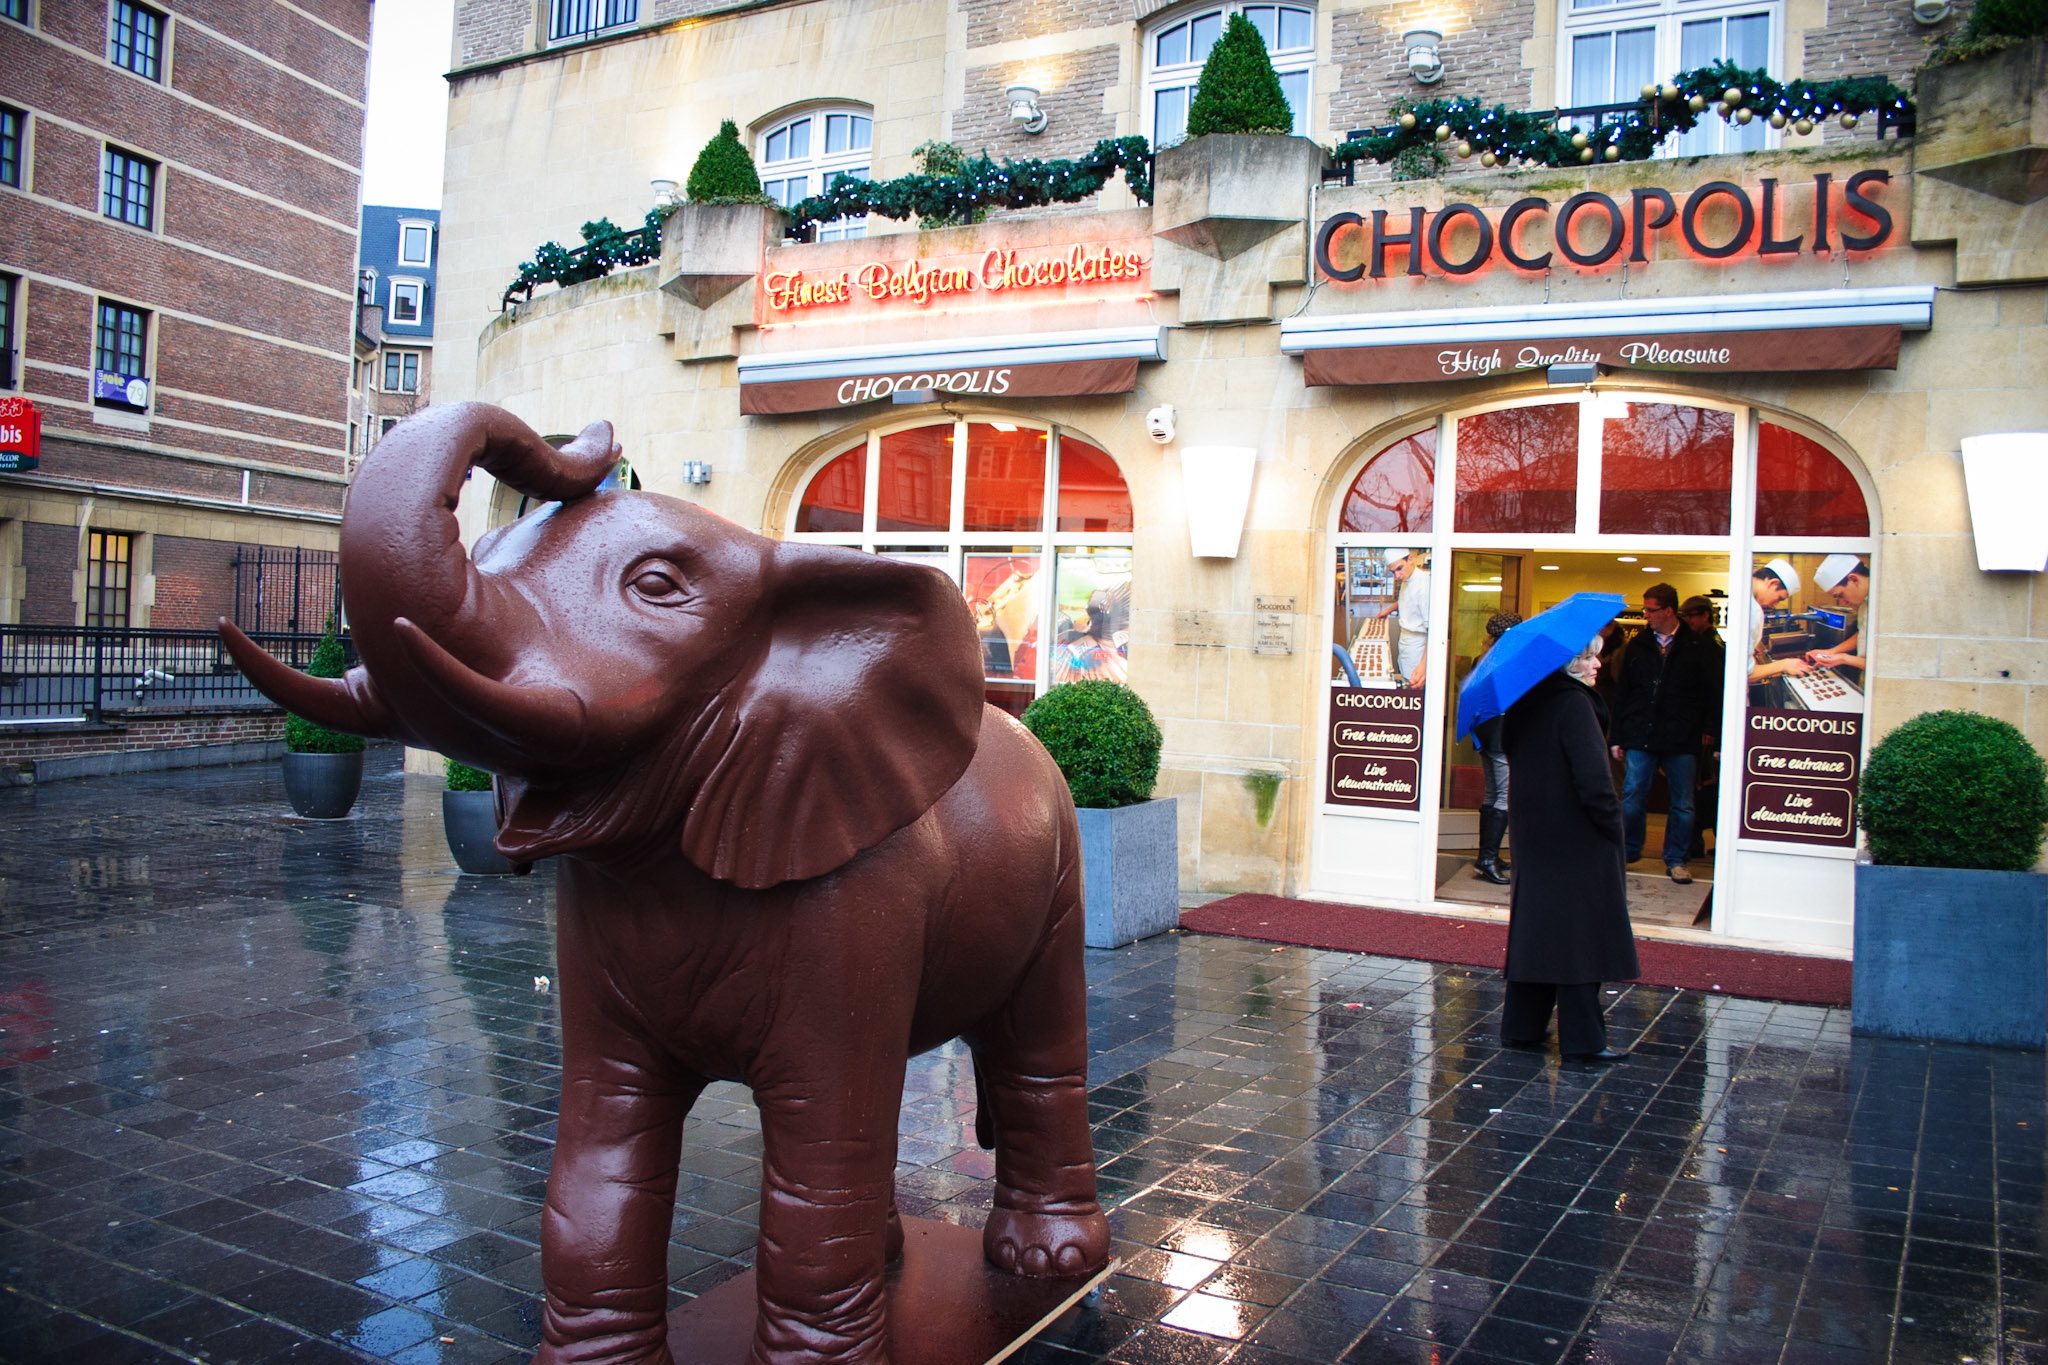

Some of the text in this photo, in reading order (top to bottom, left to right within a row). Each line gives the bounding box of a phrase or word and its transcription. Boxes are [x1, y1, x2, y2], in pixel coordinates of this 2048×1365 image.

[1315, 169, 1893, 282] CHOCOPOLIS
[764, 243, 1141, 310] Finest Belgian Chocolates
[1437, 349, 1501, 377] High
[1619, 342, 1730, 364] Pleasure
[129, 386, 144, 401] 79
[0, 424, 22, 443] bis
[1335, 693, 1422, 711] CHOCOPOLIS
[1751, 715, 1857, 735] CHOCOPOLIS
[1342, 728, 1414, 744] Free entrance
[1363, 763, 1388, 776] Live
[1757, 754, 1845, 772] Free entrance
[1336, 774, 1413, 793] demonstration
[1784, 793, 1813, 808] Live
[1750, 806, 1843, 827] demonstration
